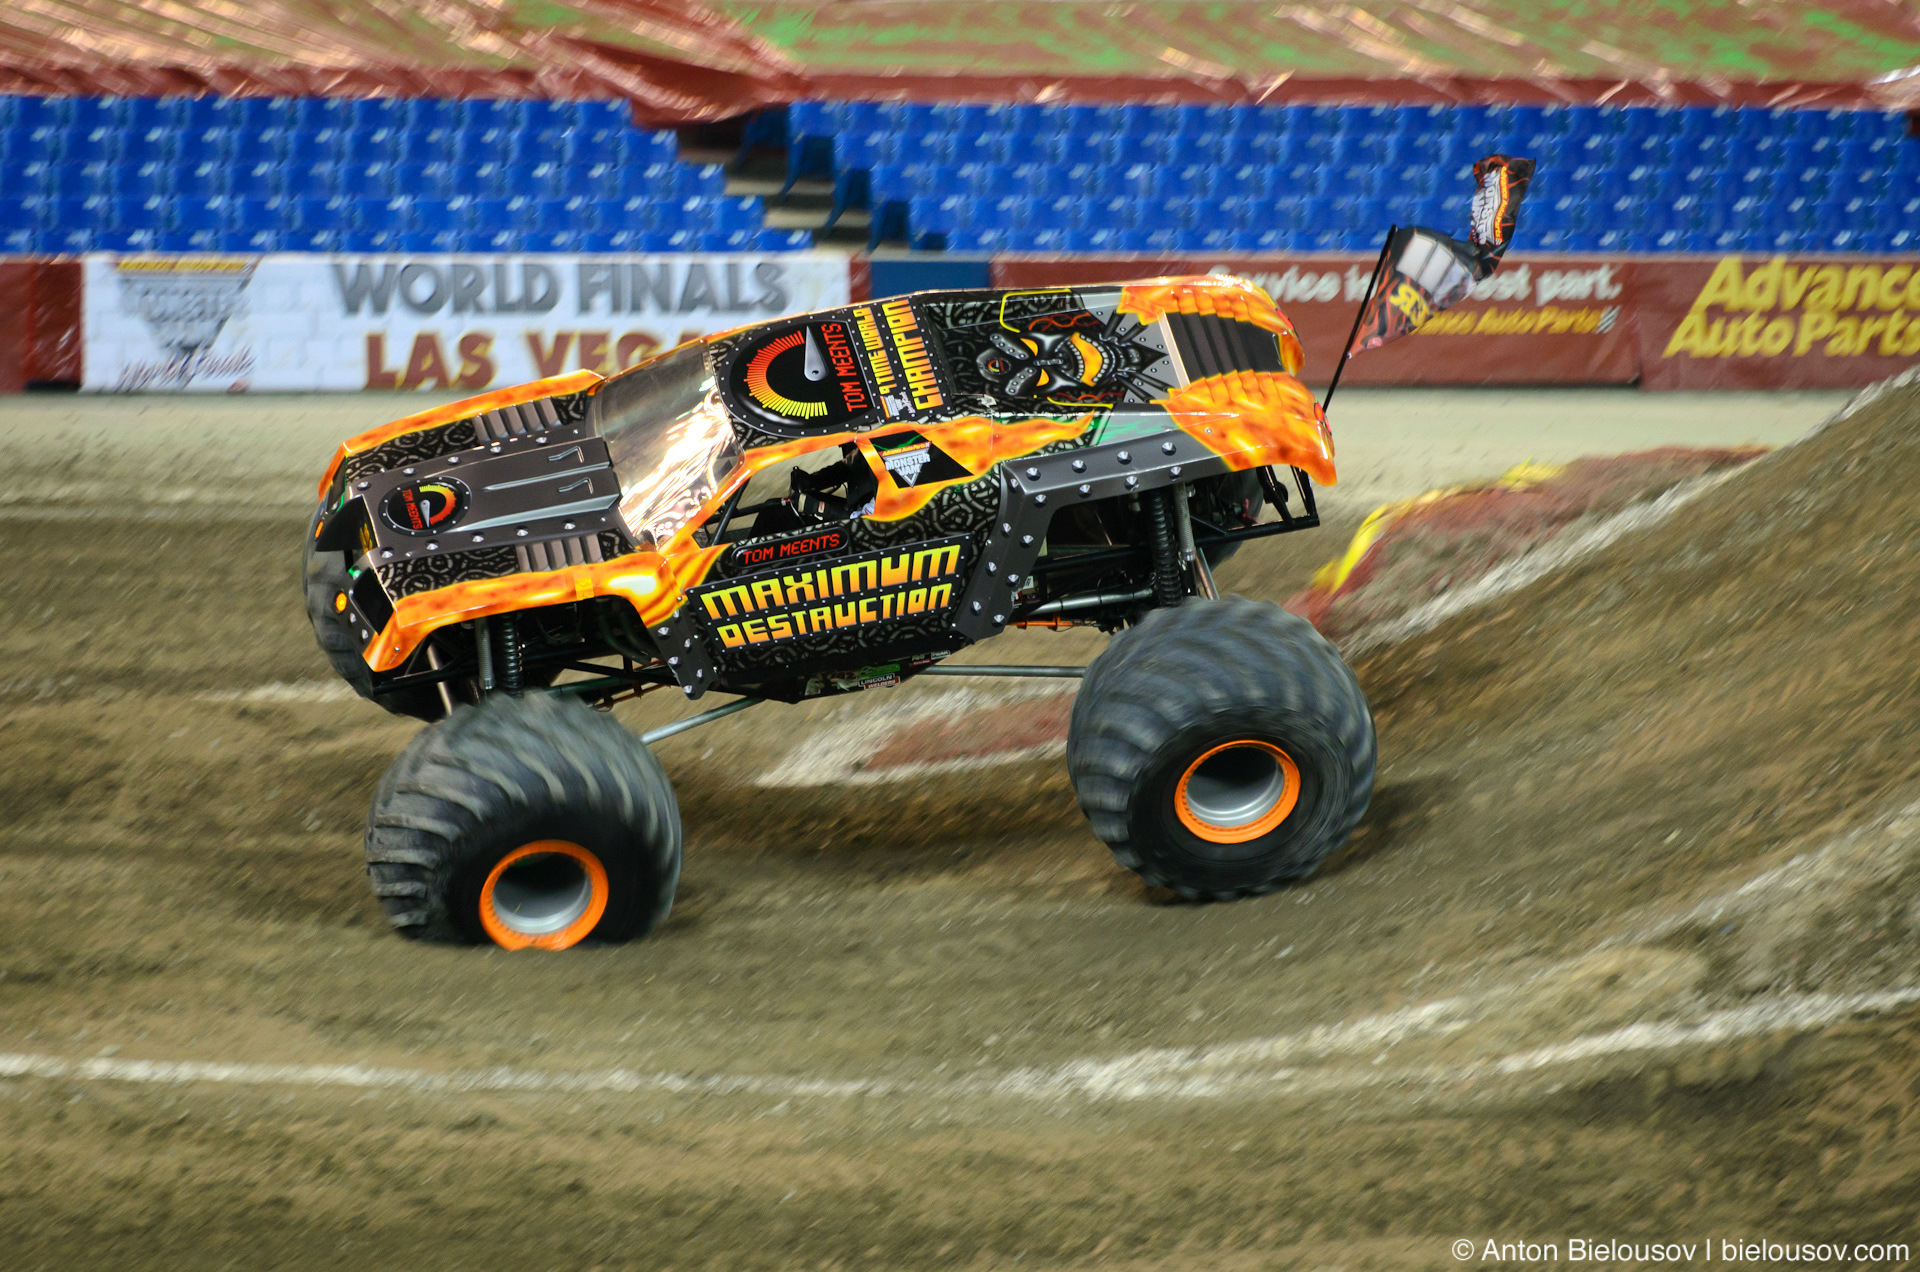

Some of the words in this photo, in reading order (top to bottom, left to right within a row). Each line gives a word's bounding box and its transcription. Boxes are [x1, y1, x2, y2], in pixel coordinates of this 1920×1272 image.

[334, 262, 560, 317] WORLD
[577, 262, 793, 315] FINALS
[853, 306, 884, 350] WORLD
[364, 330, 498, 392] LAS
[821, 322, 858, 377] MEENTS
[881, 299, 943, 410] CHAMPION
[868, 349, 896, 388] TIME
[839, 379, 868, 412] TOM
[879, 383, 897, 395] 9
[885, 453, 931, 471] MONSTER
[899, 464, 921, 476] JAM
[401, 489, 414, 502] TOM
[406, 502, 423, 530] MEENTS
[743, 546, 774, 565] TOM
[779, 533, 840, 558] MEENTS
[700, 544, 961, 620] MAXIMUM
[716, 582, 953, 649] DESTRUCTION
[860, 674, 893, 685] LINCOLN
[868, 680, 896, 689] WELDERS
